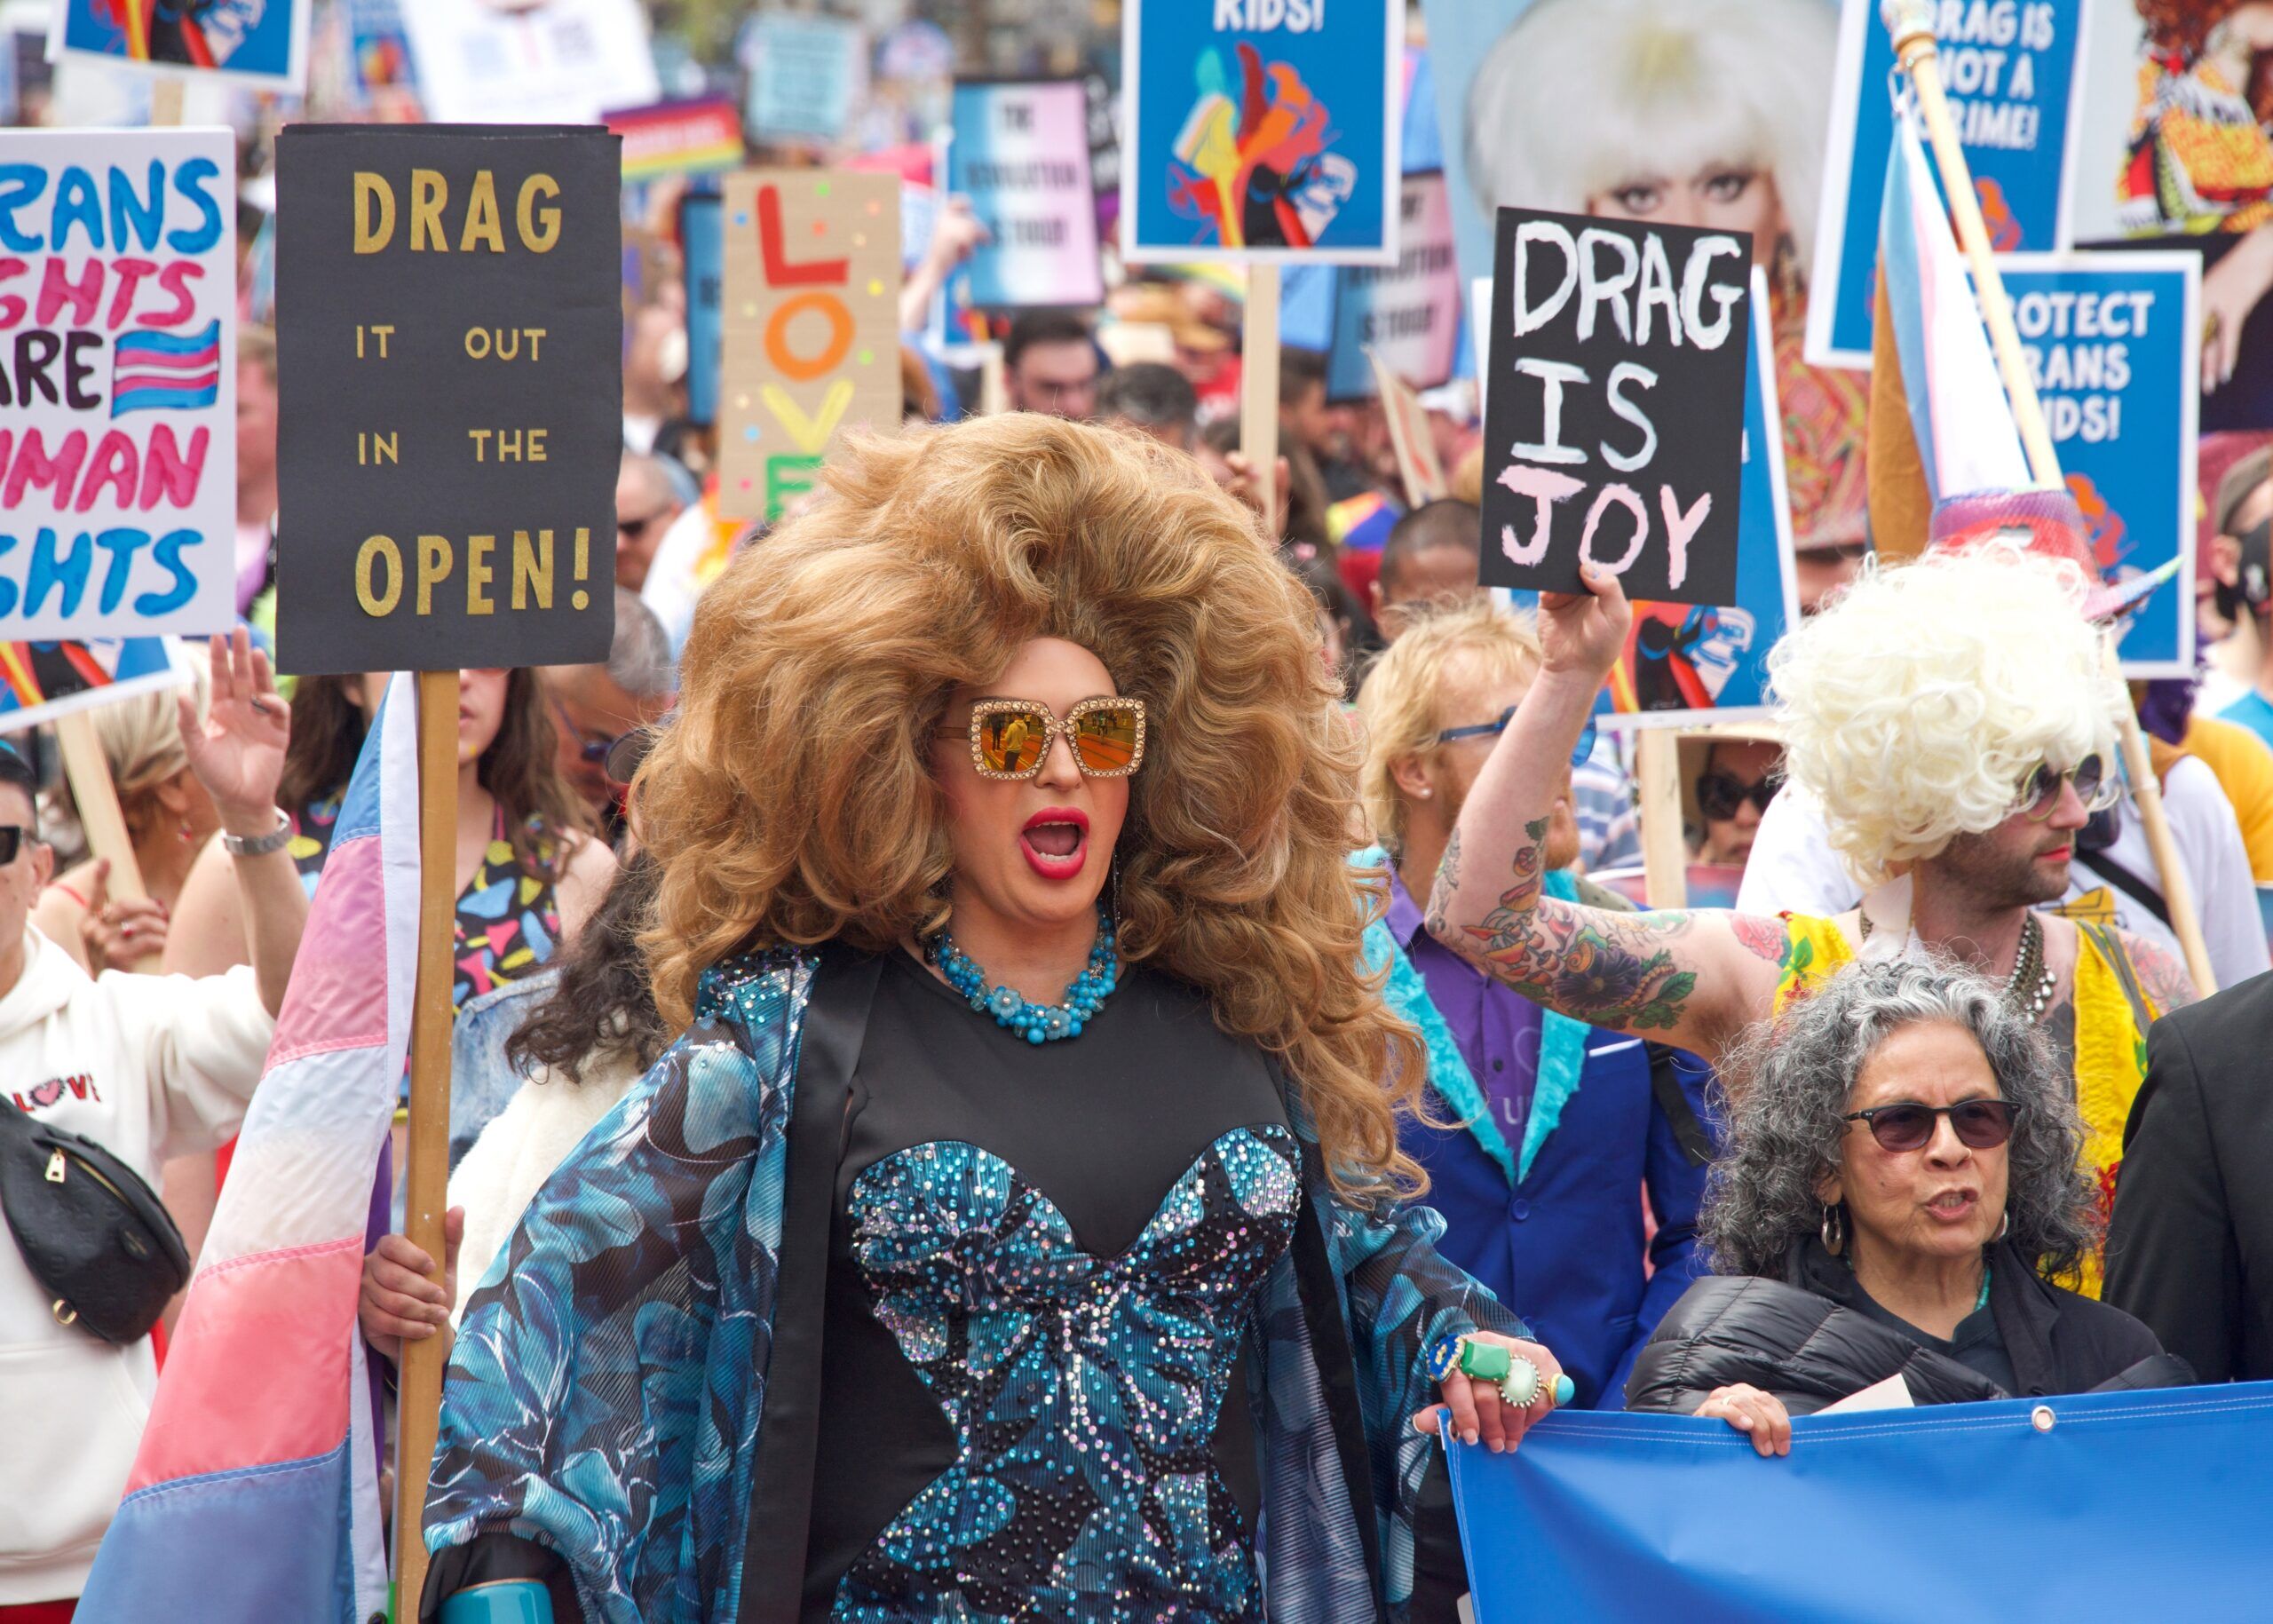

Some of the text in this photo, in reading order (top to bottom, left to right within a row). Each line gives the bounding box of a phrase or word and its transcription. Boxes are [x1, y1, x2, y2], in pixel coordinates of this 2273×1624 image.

[1214, 0, 1325, 34] KIDS!
[1936, 0, 2055, 51] RAG IS
[2008, 52, 2035, 100] A
[354, 168, 561, 255] DRAG
[1513, 220, 1744, 350] DRAG
[2005, 290, 2155, 338] OTECT
[357, 325, 547, 360] IT OUT
[2019, 342, 2131, 391] RANS
[0, 329, 104, 410] RE
[1510, 357, 1659, 472] IS
[2040, 394, 2121, 443] IDS!
[359, 429, 547, 464] IN THE
[1495, 464, 1713, 590] JOY
[355, 527, 590, 617] OPEN!
